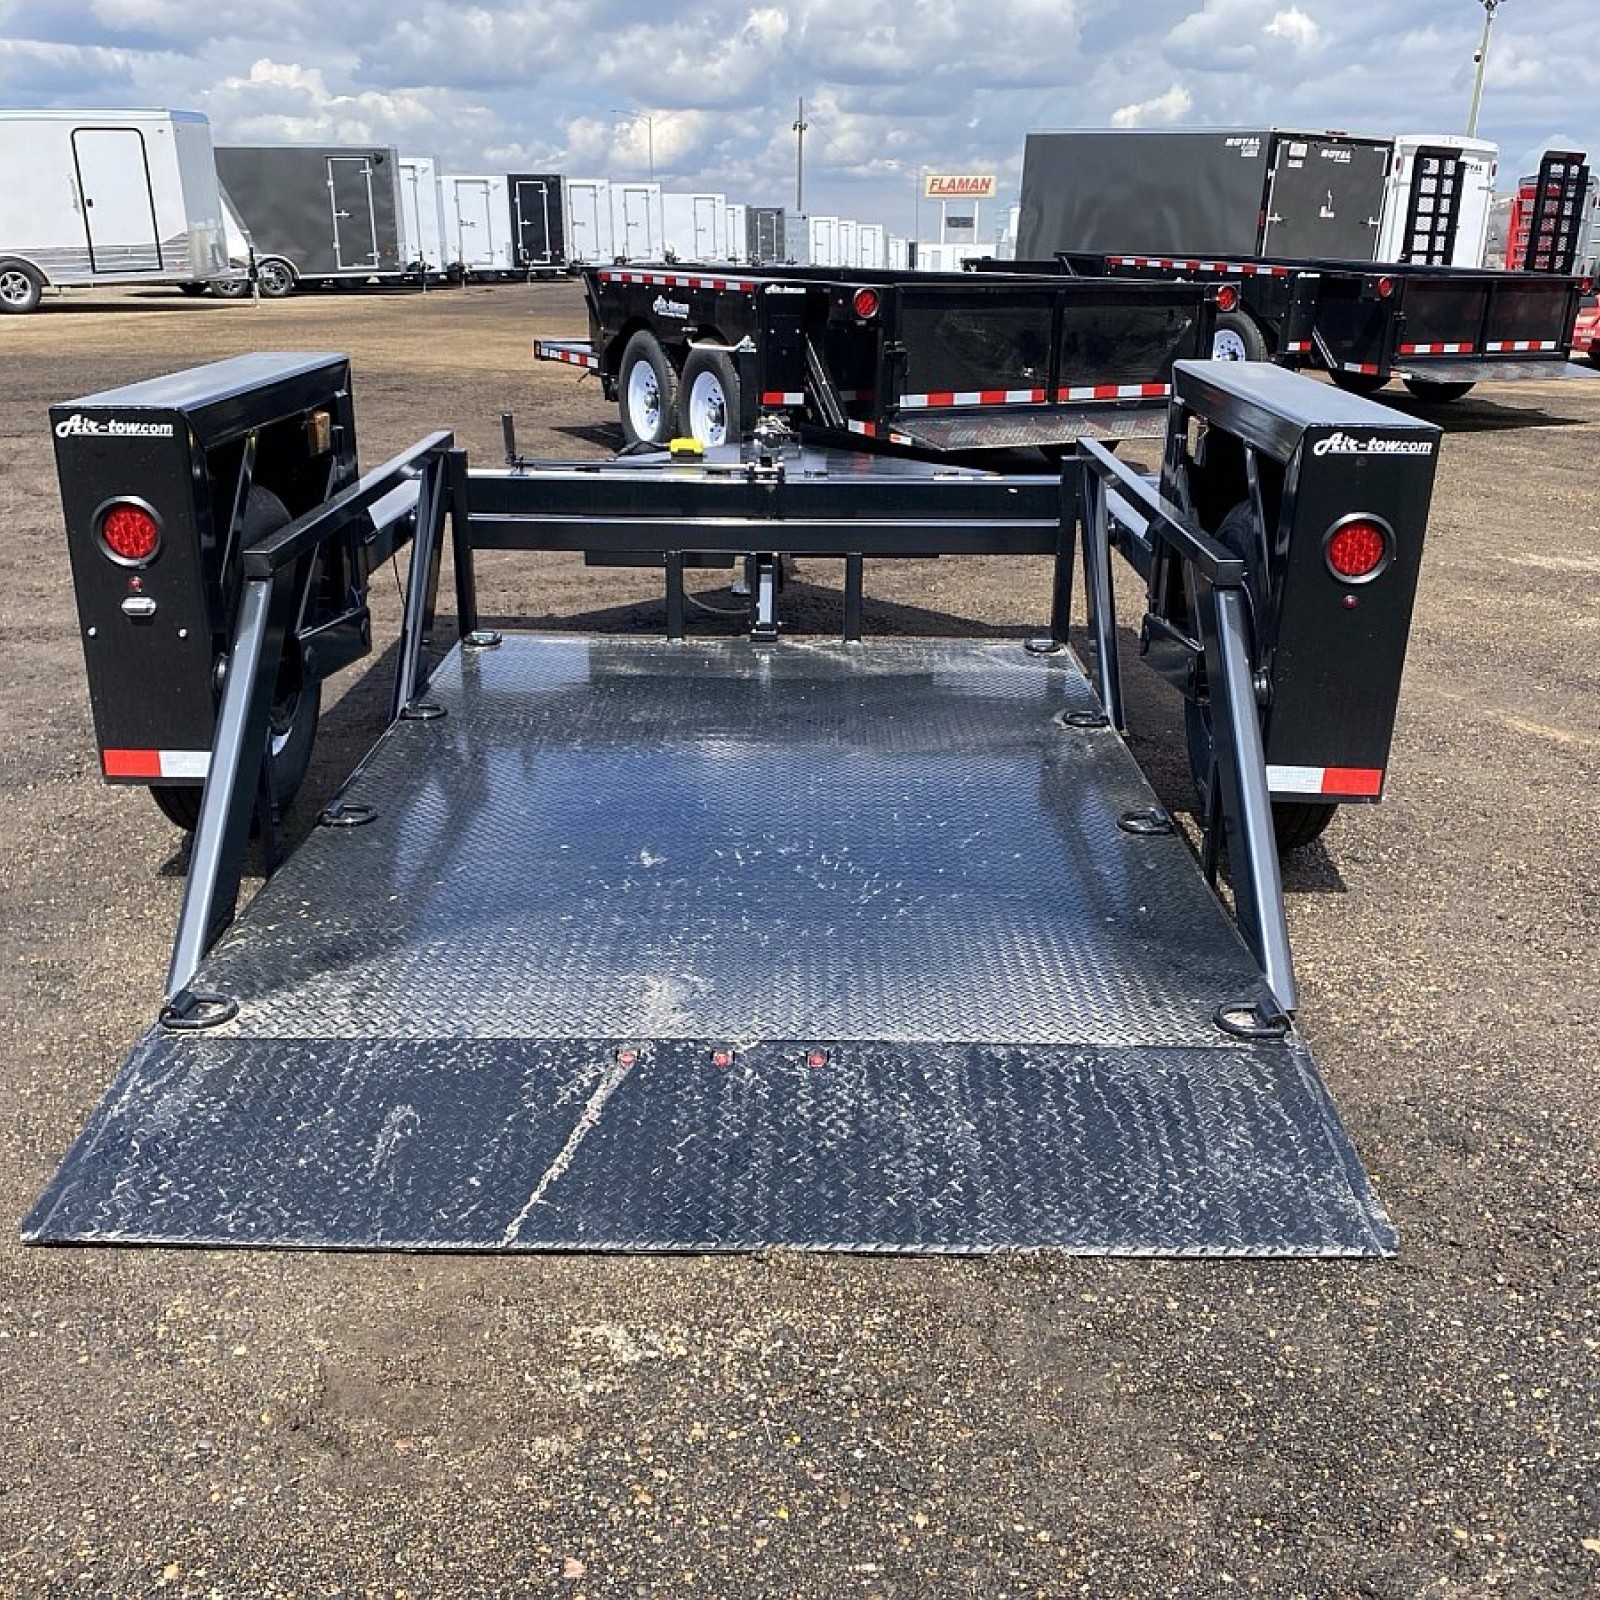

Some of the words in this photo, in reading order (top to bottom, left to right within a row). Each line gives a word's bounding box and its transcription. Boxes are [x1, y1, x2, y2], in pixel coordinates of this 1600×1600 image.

[1225, 137, 1261, 146] ROYAL
[1321, 149, 1351, 159] ROYAL
[930, 177, 991, 191] FLAMAN
[56, 414, 173, 437] Air-tow.com
[1313, 432, 1432, 455] Air-tow.com
